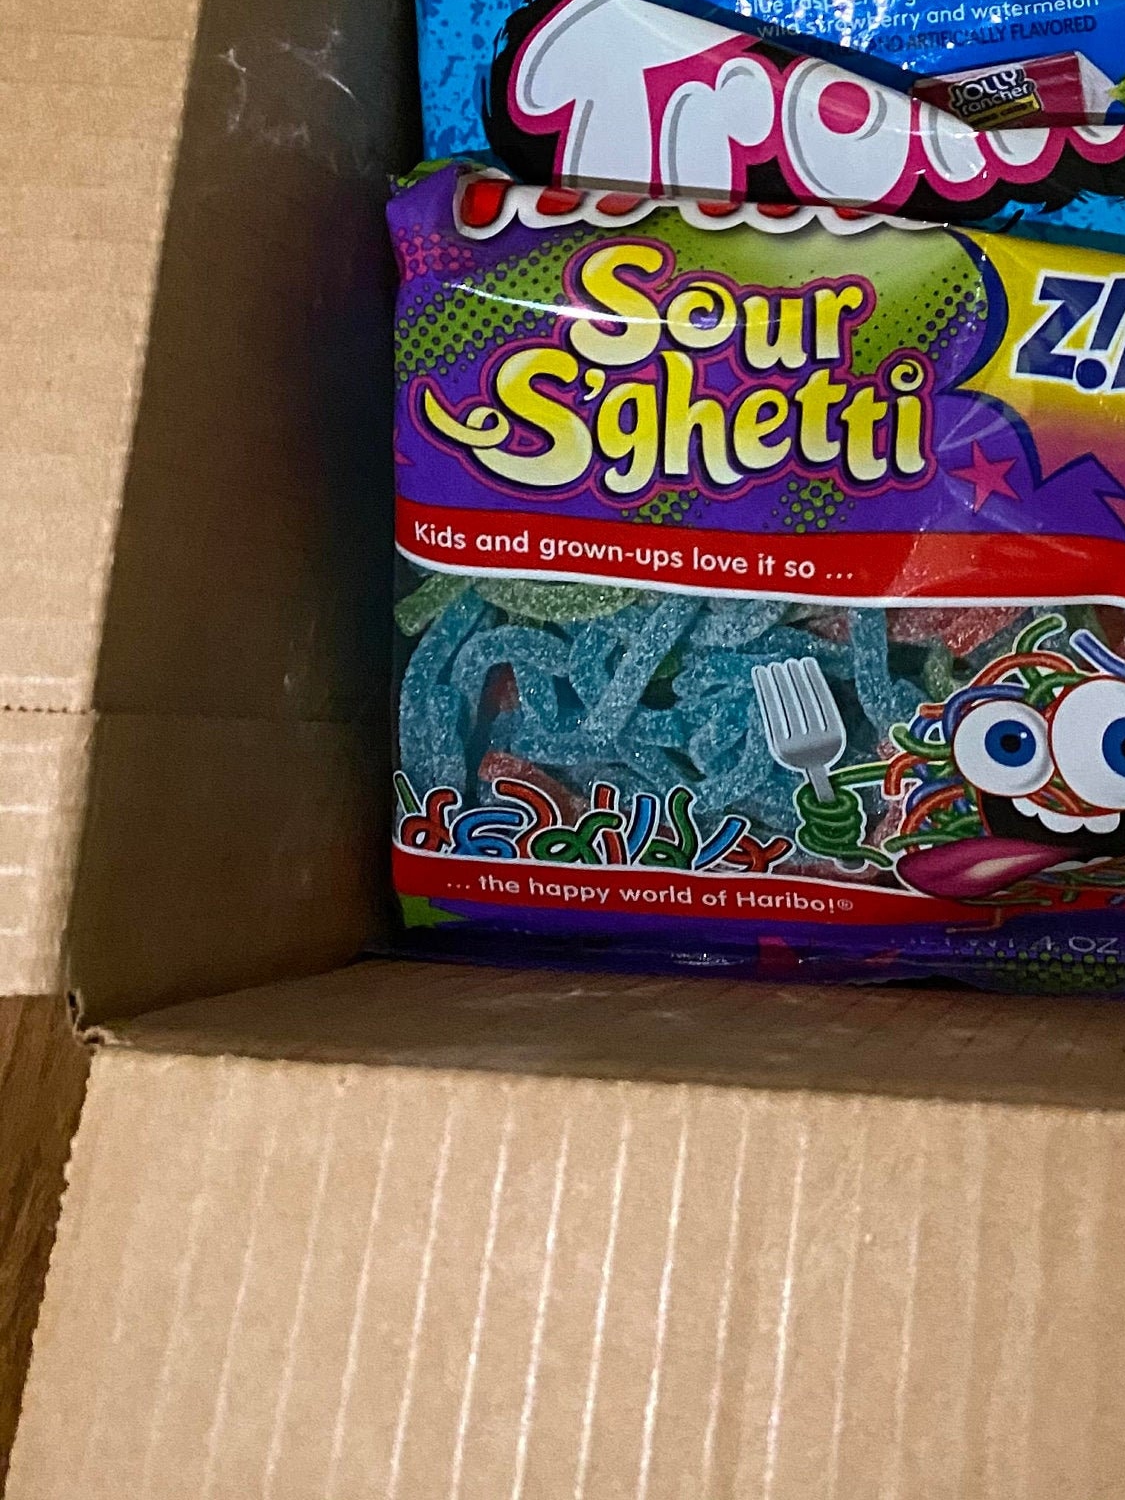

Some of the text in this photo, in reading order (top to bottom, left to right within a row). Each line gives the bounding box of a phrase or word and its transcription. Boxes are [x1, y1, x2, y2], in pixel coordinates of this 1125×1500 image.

[926, 5, 965, 24] and
[1010, 15, 1097, 40] FLAVORED
[955, 71, 1019, 105] JOLLY
[962, 84, 1031, 114] rancher
[571, 245, 868, 368] Sour
[422, 346, 927, 495] S'ghetti
[414, 521, 466, 549] Kids
[475, 531, 529, 553] and
[539, 536, 684, 570] grown-ups
[692, 546, 749, 573] love
[757, 553, 776, 576] it
[784, 559, 816, 579] so
[478, 875, 520, 895] the
[529, 878, 610, 904] happy
[618, 885, 693, 905] world
[701, 889, 728, 908] of
[1068, 935, 1119, 954] OZ
